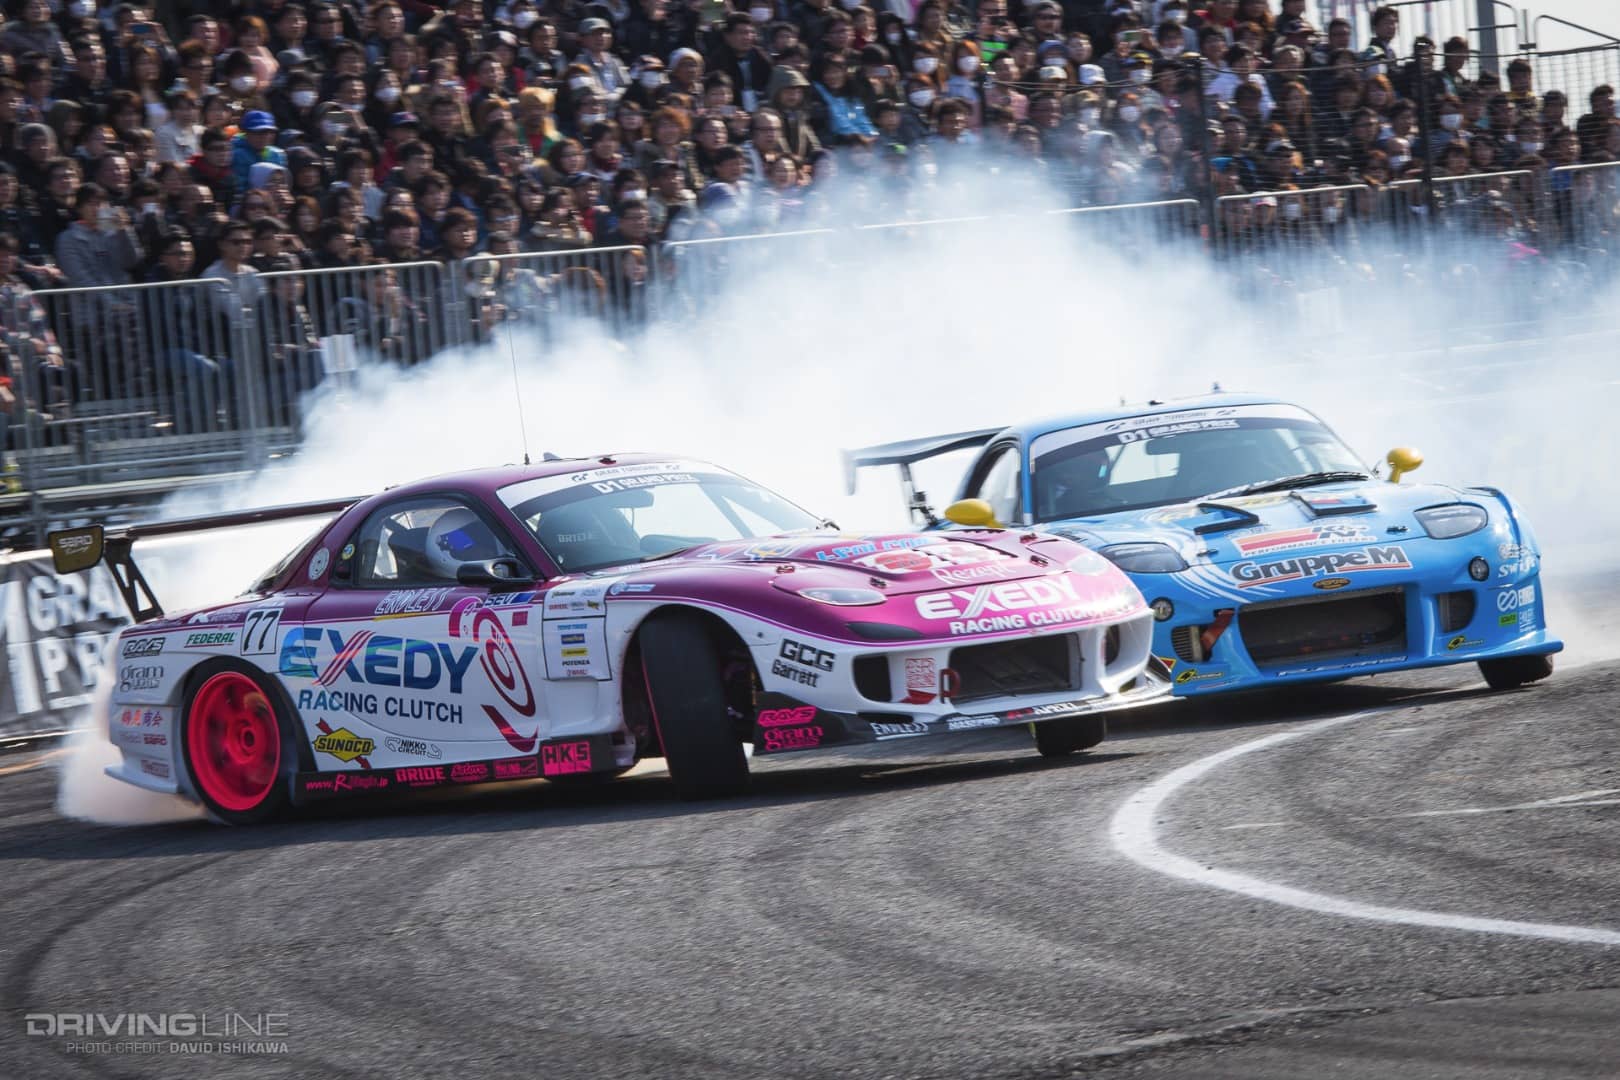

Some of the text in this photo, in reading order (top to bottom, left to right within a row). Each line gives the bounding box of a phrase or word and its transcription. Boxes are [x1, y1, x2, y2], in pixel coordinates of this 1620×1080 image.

[1118, 428, 1150, 444] D1
[592, 480, 624, 494] D1
[1231, 547, 1408, 582] GruppeM
[27, 563, 125, 631] GRA
[374, 587, 456, 614] ENDLESS
[914, 575, 1080, 620] EXEDY
[243, 610, 280, 652] 77
[950, 614, 1026, 635] RACING
[185, 632, 236, 645] FEDERAL
[278, 627, 479, 695] EXEDY
[780, 638, 836, 672] GCG
[120, 665, 164, 693] gram
[771, 659, 820, 688] Garrett
[297, 690, 464, 724] RACING CLUTCH
[316, 738, 373, 753] SUNOCO
[400, 739, 427, 751] NIKKO
[543, 742, 590, 766] HKS
[395, 766, 446, 783] BRIDE
